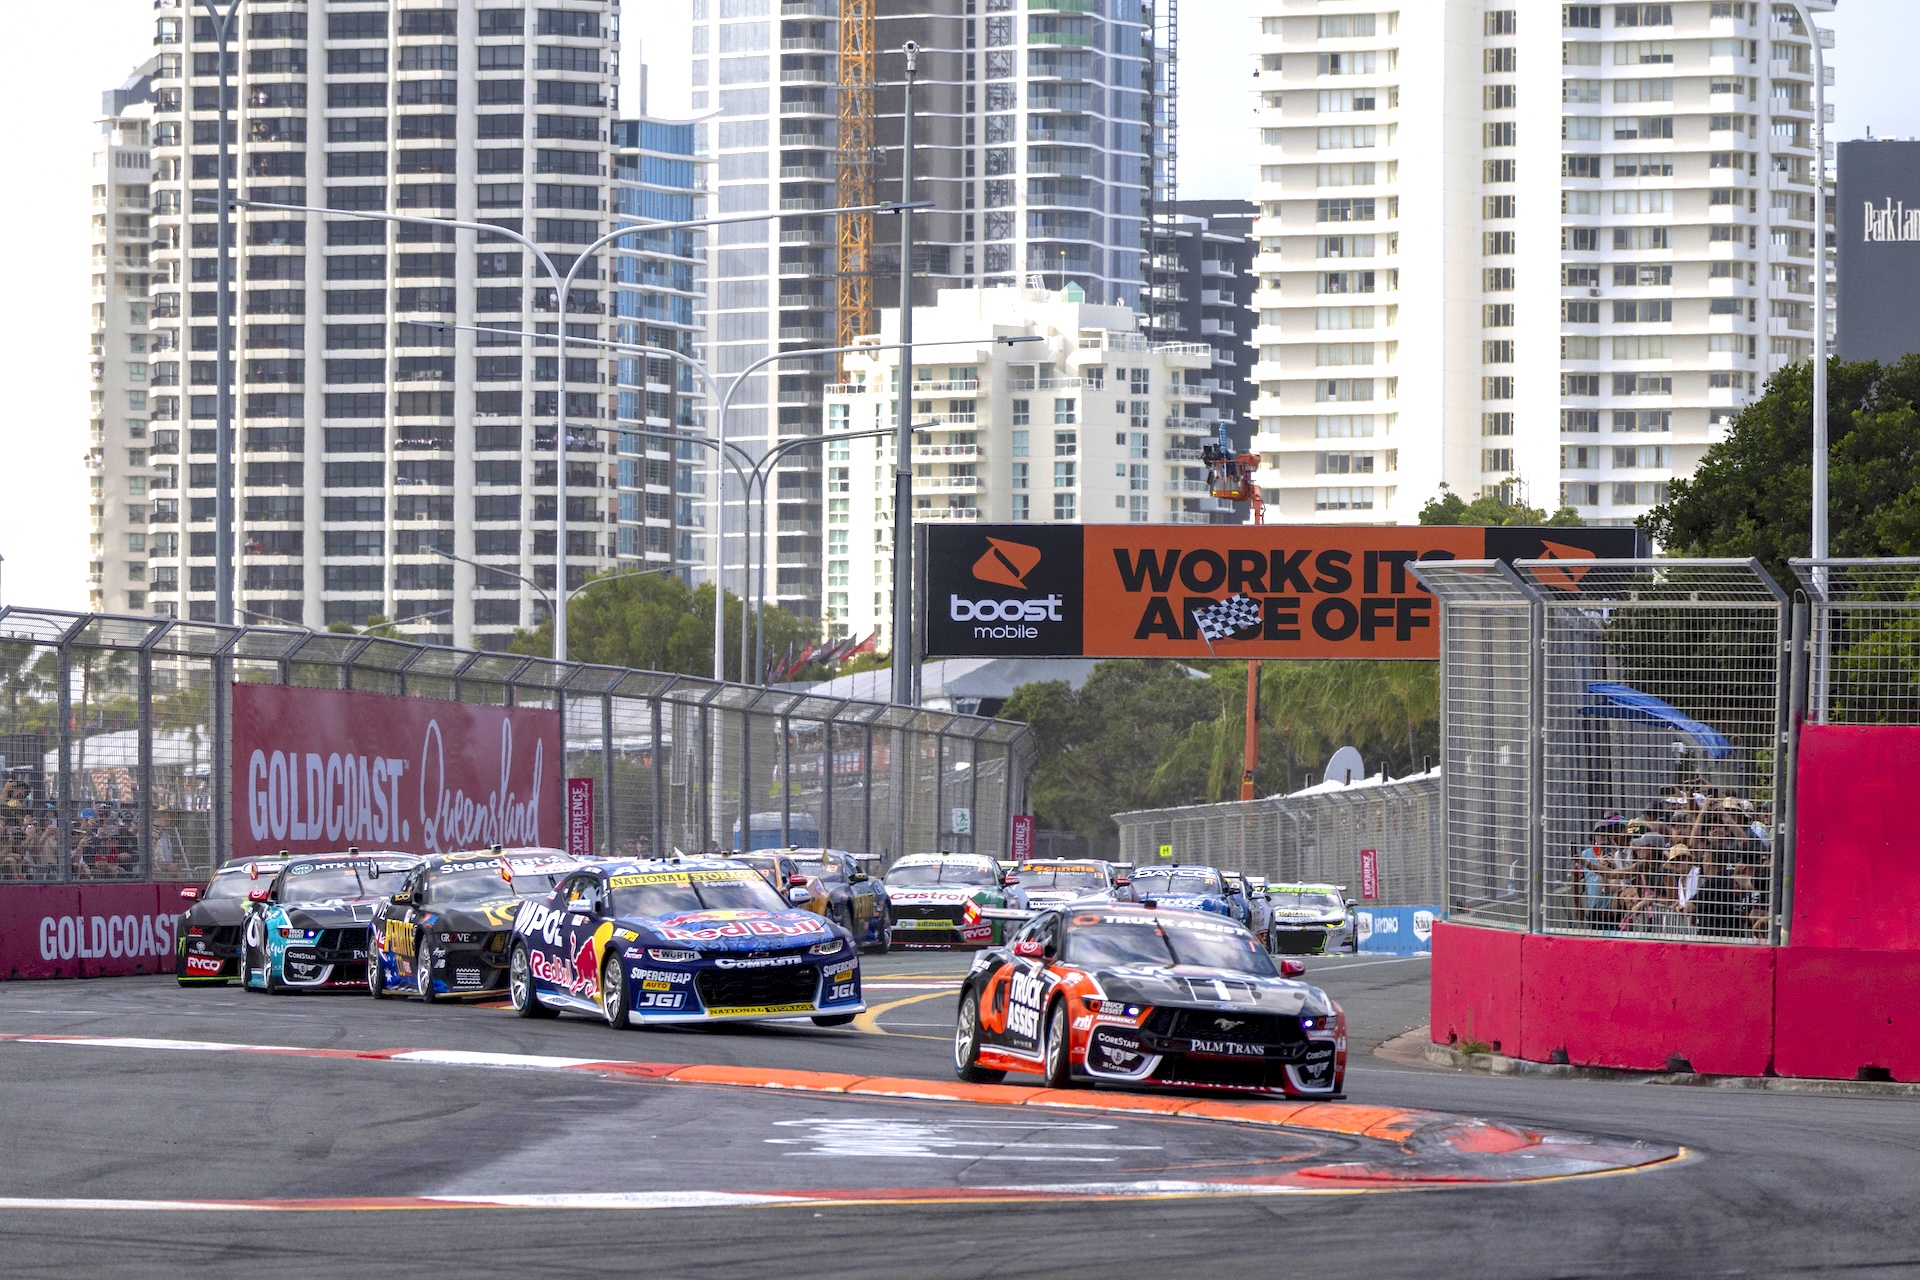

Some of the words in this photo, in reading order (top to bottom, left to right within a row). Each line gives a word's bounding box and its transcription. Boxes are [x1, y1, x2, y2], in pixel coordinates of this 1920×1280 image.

[1863, 197, 1896, 242] Park
[1113, 549, 1353, 594] WORKS
[950, 594, 1063, 622] boost
[1134, 596, 1300, 640] AE
[1311, 597, 1430, 641] OFF
[974, 625, 1039, 639] mobile
[419, 717, 543, 854] Queensland
[1015, 821, 1025, 860] ERIENCE
[315, 862, 346, 870] NTK
[613, 873, 686, 886] NATIONAL
[692, 872, 757, 882] STORAGE
[1363, 855, 1372, 895] EXPERIENCE
[658, 922, 748, 941] Red
[748, 918, 826, 936] Bull
[963, 928, 992, 939] RYCO
[1103, 915, 1174, 927] TRUCK
[1178, 920, 1247, 936] ASSIST
[1374, 916, 1398, 934] HYDRO
[440, 933, 471, 943] GROVE
[352, 949, 369, 960] PAL
[187, 957, 221, 971] RYCO
[630, 967, 692, 985] SUPERCHEAP
[835, 972, 852, 980] AUTO
[828, 983, 856, 1000] JGI
[1009, 971, 1045, 1011] TRUCK
[639, 993, 683, 1007] JGI
[1101, 1000, 1125, 1009] TRUCK
[709, 1007, 764, 1016] NATIONAL
[765, 1005, 816, 1013] STORAGE
[1099, 1006, 1124, 1015] ASSIST
[1006, 1000, 1041, 1040] ASSIST
[1096, 1014, 1137, 1025] GEARWRENCH
[1191, 1038, 1224, 1053] PALM
[1226, 1041, 1265, 1056] TRANS
